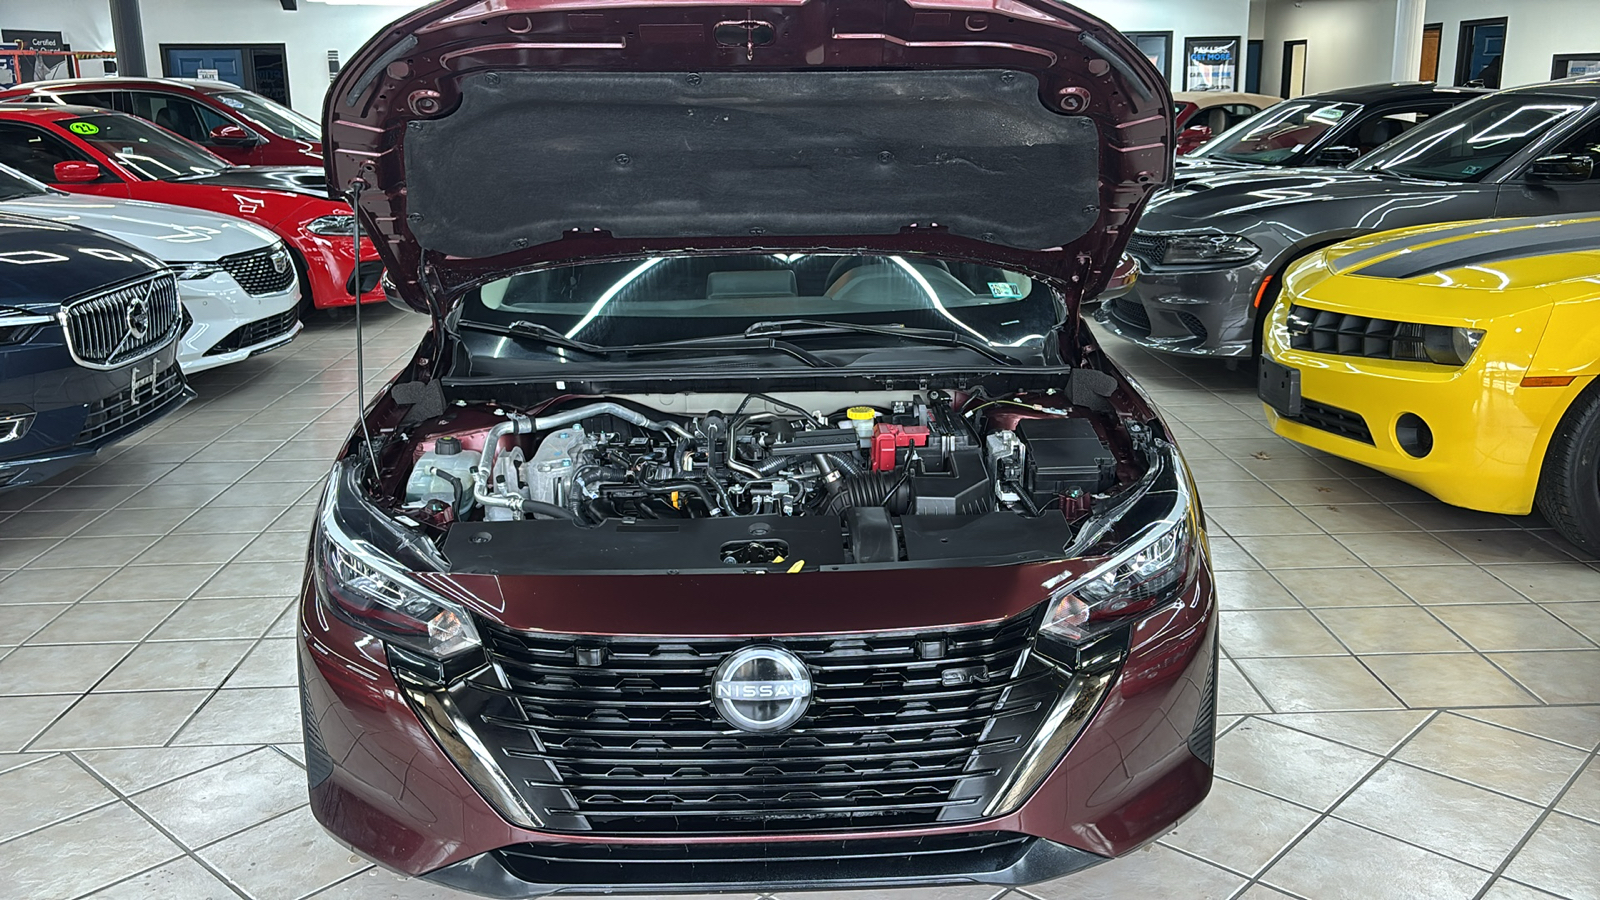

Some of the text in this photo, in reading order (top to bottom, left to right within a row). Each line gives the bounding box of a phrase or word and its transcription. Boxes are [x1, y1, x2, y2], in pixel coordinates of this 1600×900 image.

[32, 38, 56, 46] Certified
[75, 124, 95, 133] 22
[717, 683, 806, 698] NISSAN
